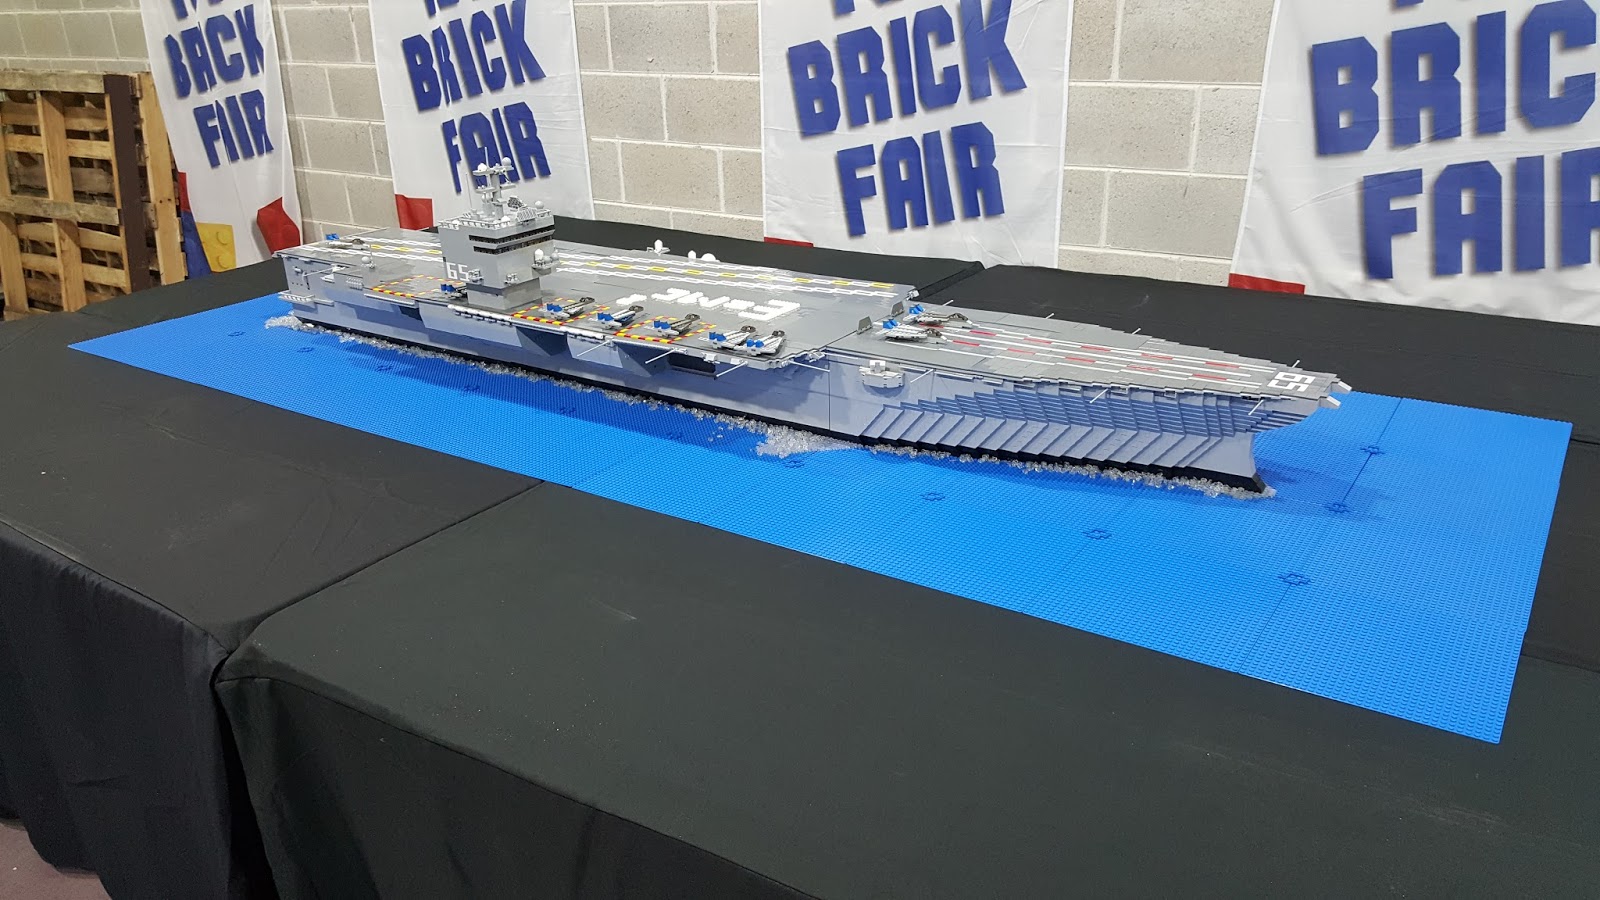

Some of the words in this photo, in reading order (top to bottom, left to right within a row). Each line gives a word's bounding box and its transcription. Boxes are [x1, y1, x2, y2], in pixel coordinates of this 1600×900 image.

[402, 0, 547, 112] BRICK
[788, 0, 1027, 137] BRICK
[442, 101, 551, 194] FAIR
[837, 121, 1005, 236] FAIR
[446, 262, 470, 282] 65
